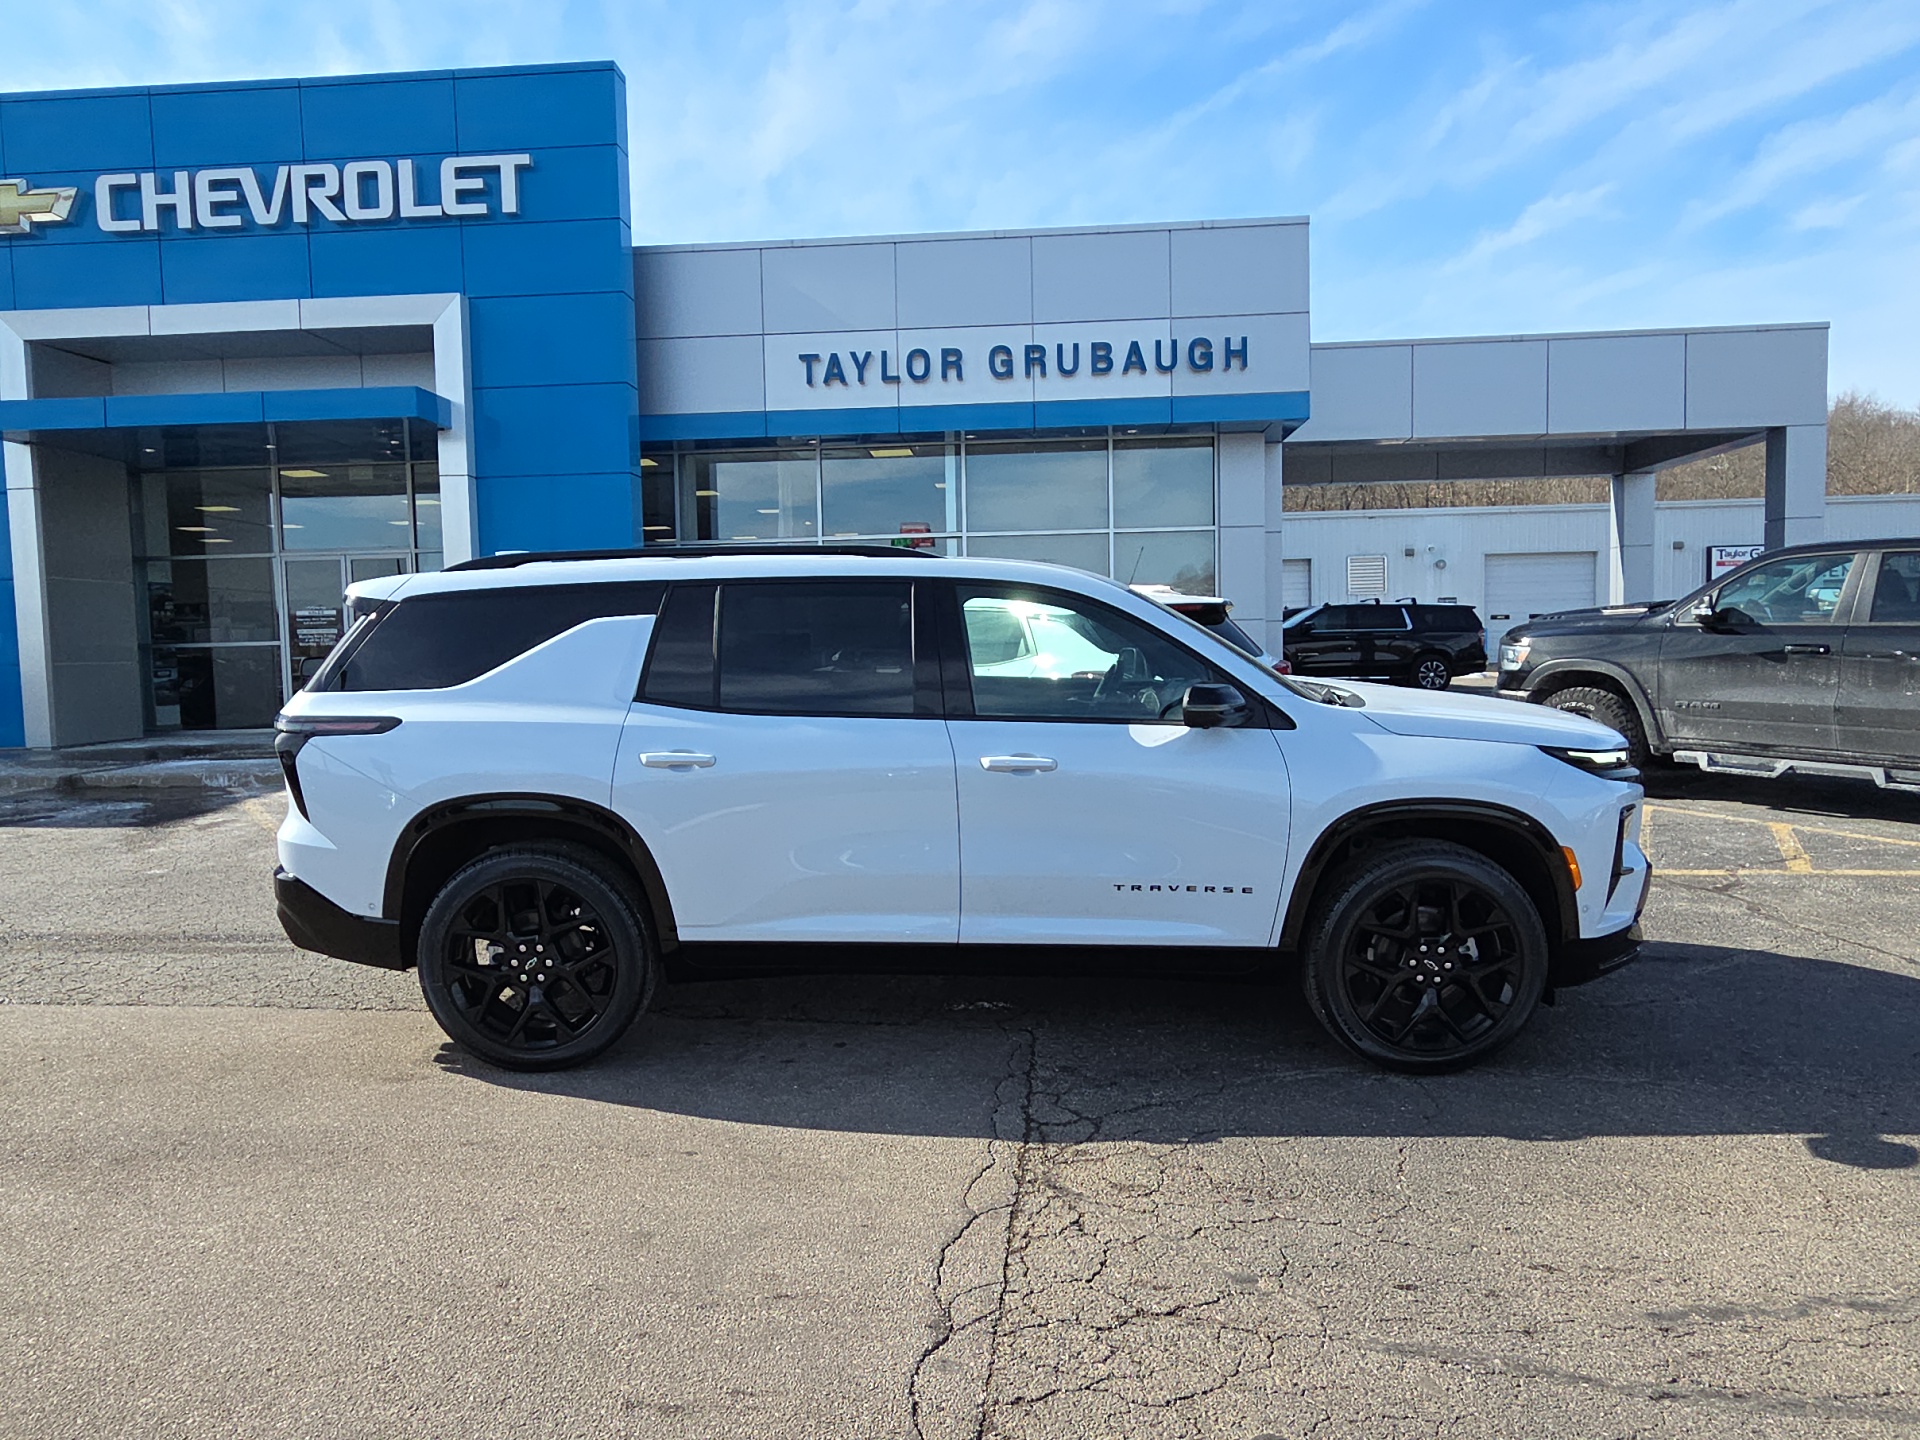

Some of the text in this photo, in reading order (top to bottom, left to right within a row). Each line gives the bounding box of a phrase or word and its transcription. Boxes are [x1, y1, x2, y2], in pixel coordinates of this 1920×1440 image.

[95, 153, 531, 232] CHEVROLET
[799, 335, 1249, 386] TAYLOR GRUBAUGH
[1716, 548, 1748, 560] Taylor
[1113, 884, 1253, 894] TRAVERSE
